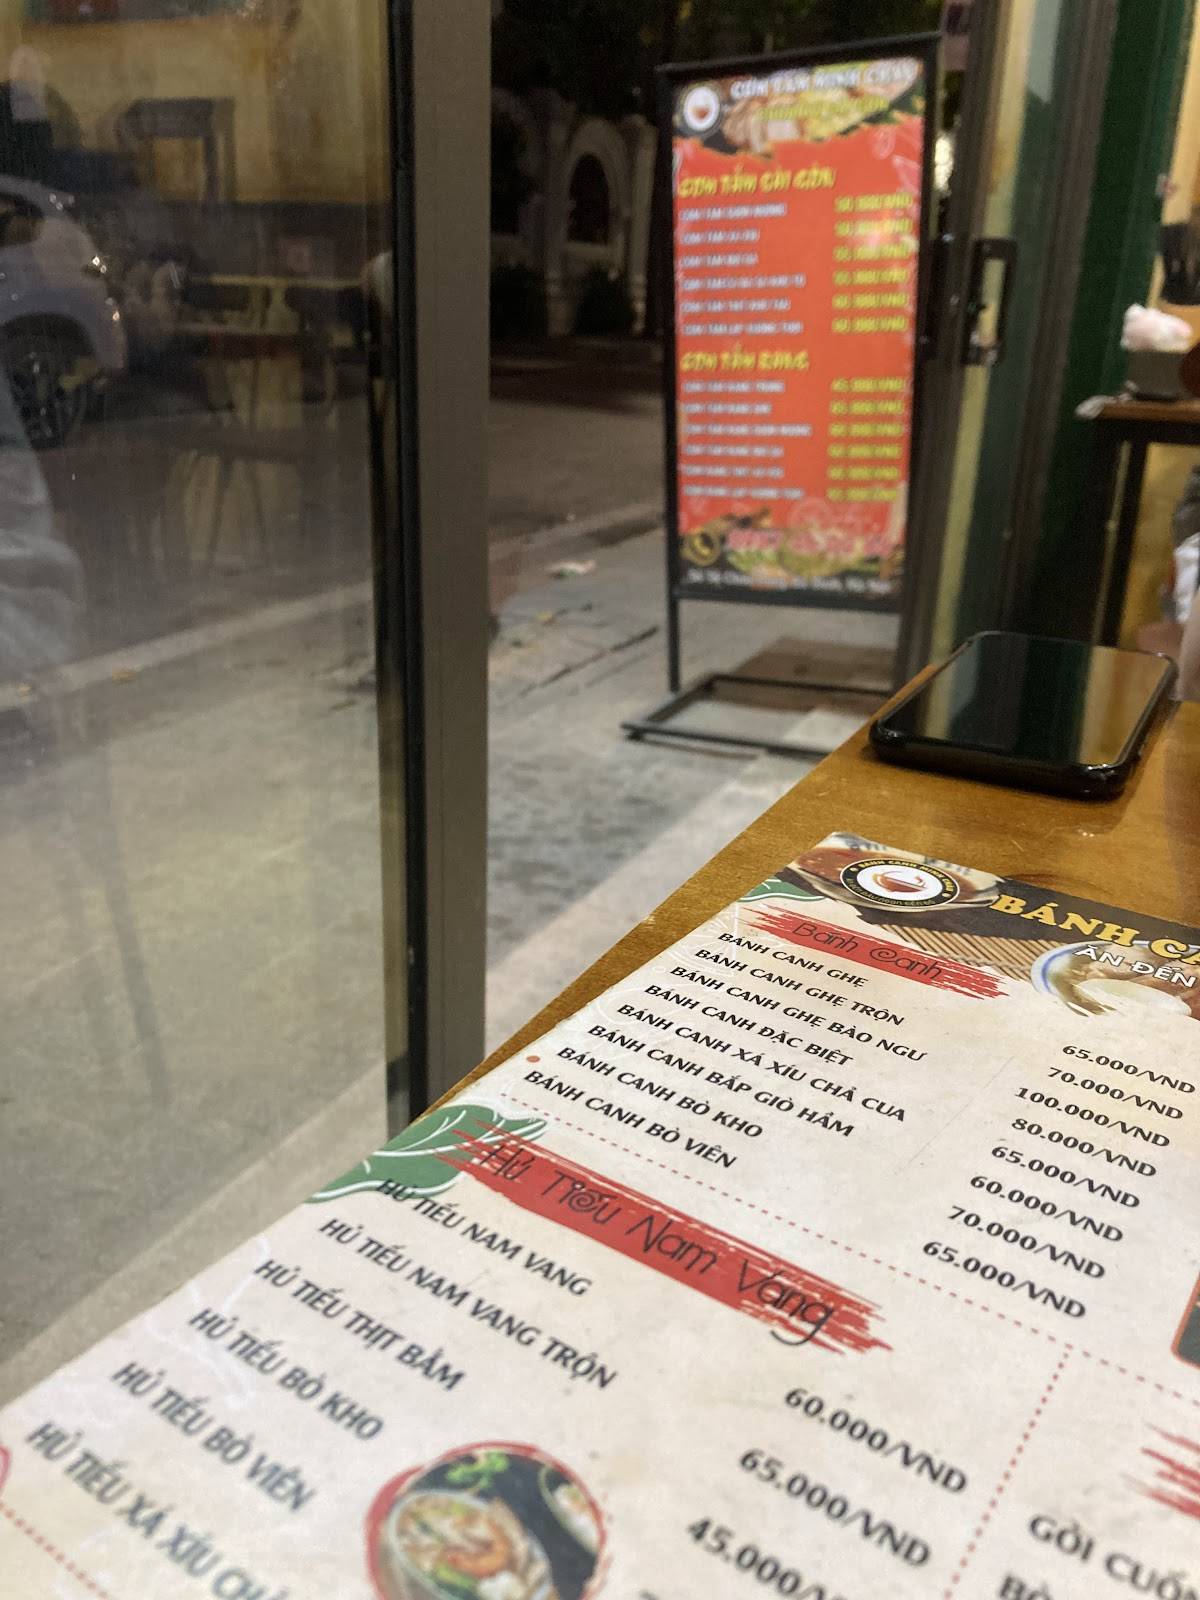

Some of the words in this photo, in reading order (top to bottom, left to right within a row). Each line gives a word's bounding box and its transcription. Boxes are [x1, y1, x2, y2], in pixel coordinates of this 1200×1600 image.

[792, 921, 859, 953] Bánh
[869, 946, 943, 982] Canh
[989, 894, 1140, 947] BÁNH
[695, 949, 748, 972] BÁNH
[750, 968, 803, 992] CANH
[805, 987, 848, 1008] GHẸ
[850, 1001, 904, 1026] TRỘN
[718, 933, 768, 954] BÁNH
[772, 950, 824, 973] CANH
[826, 968, 869, 988] GHẸ
[1130, 960, 1197, 989] ĐẾN
[644, 985, 700, 1010] BÁNH
[701, 1006, 757, 1031] CANH
[758, 1026, 804, 1049] ĐẶC
[804, 1043, 854, 1066] BIỆT
[669, 966, 724, 990] BÁNH
[726, 986, 781, 1011] CANH
[783, 1005, 826, 1028] GHẸ
[827, 1021, 873, 1043] BÀO
[876, 1038, 928, 1062] NGƯ
[556, 1047, 616, 1076] BÁNH
[617, 1072, 676, 1102] CANH
[676, 1095, 711, 1115] BÒ
[712, 1110, 763, 1138] KHO
[587, 1025, 646, 1052] BÁNH
[646, 1049, 704, 1077] CANH
[705, 1071, 752, 1093] BẮP
[754, 1090, 794, 1112] GIÒ
[617, 1004, 674, 1031] BÁNH
[675, 1026, 732, 1053] CANH
[731, 1047, 765, 1067] XÁ
[764, 1060, 808, 1081] XÍU
[810, 1077, 857, 1102] CHẢ
[861, 1097, 906, 1122] CUA
[1048, 1066, 1184, 1120] 70.000/VND
[1062, 1045, 1196, 1094] 65.000/VND
[523, 1071, 586, 1102] BÁNH
[585, 1097, 646, 1128] CANH
[645, 1122, 680, 1144] BÒ
[684, 1137, 738, 1168] VIÊN
[1011, 1118, 1157, 1177] 80.000/VND
[1014, 1087, 1171, 1147] 100.000/VND
[970, 1175, 1124, 1242] 60.000/VND
[991, 1145, 1141, 1209] 65.000/VND
[413, 1196, 466, 1229] TIẾU
[462, 1222, 524, 1260] NAM
[524, 1251, 593, 1296] VANG
[624, 1214, 718, 1275] Nam
[737, 1258, 834, 1347] Vang
[922, 1241, 1087, 1319] 65.000/VND
[948, 1205, 1106, 1279] 70.000/VND
[291, 1279, 351, 1320] TIẾU
[344, 1310, 405, 1351] THỊT
[319, 1218, 364, 1246] HỦ
[358, 1238, 412, 1273] TIẾU
[407, 1265, 470, 1308] NAM
[469, 1298, 542, 1347] VANG
[540, 1336, 620, 1389] TRỘN
[226, 1330, 288, 1376] TIẾU
[318, 1391, 385, 1441] KHO
[64, 1450, 133, 1504] TIẾU
[150, 1386, 215, 1437] TIẾU
[246, 1453, 317, 1511] VIÊN
[783, 1386, 968, 1494] 60.000/VND
[738, 1447, 932, 1568] 65.000/VND
